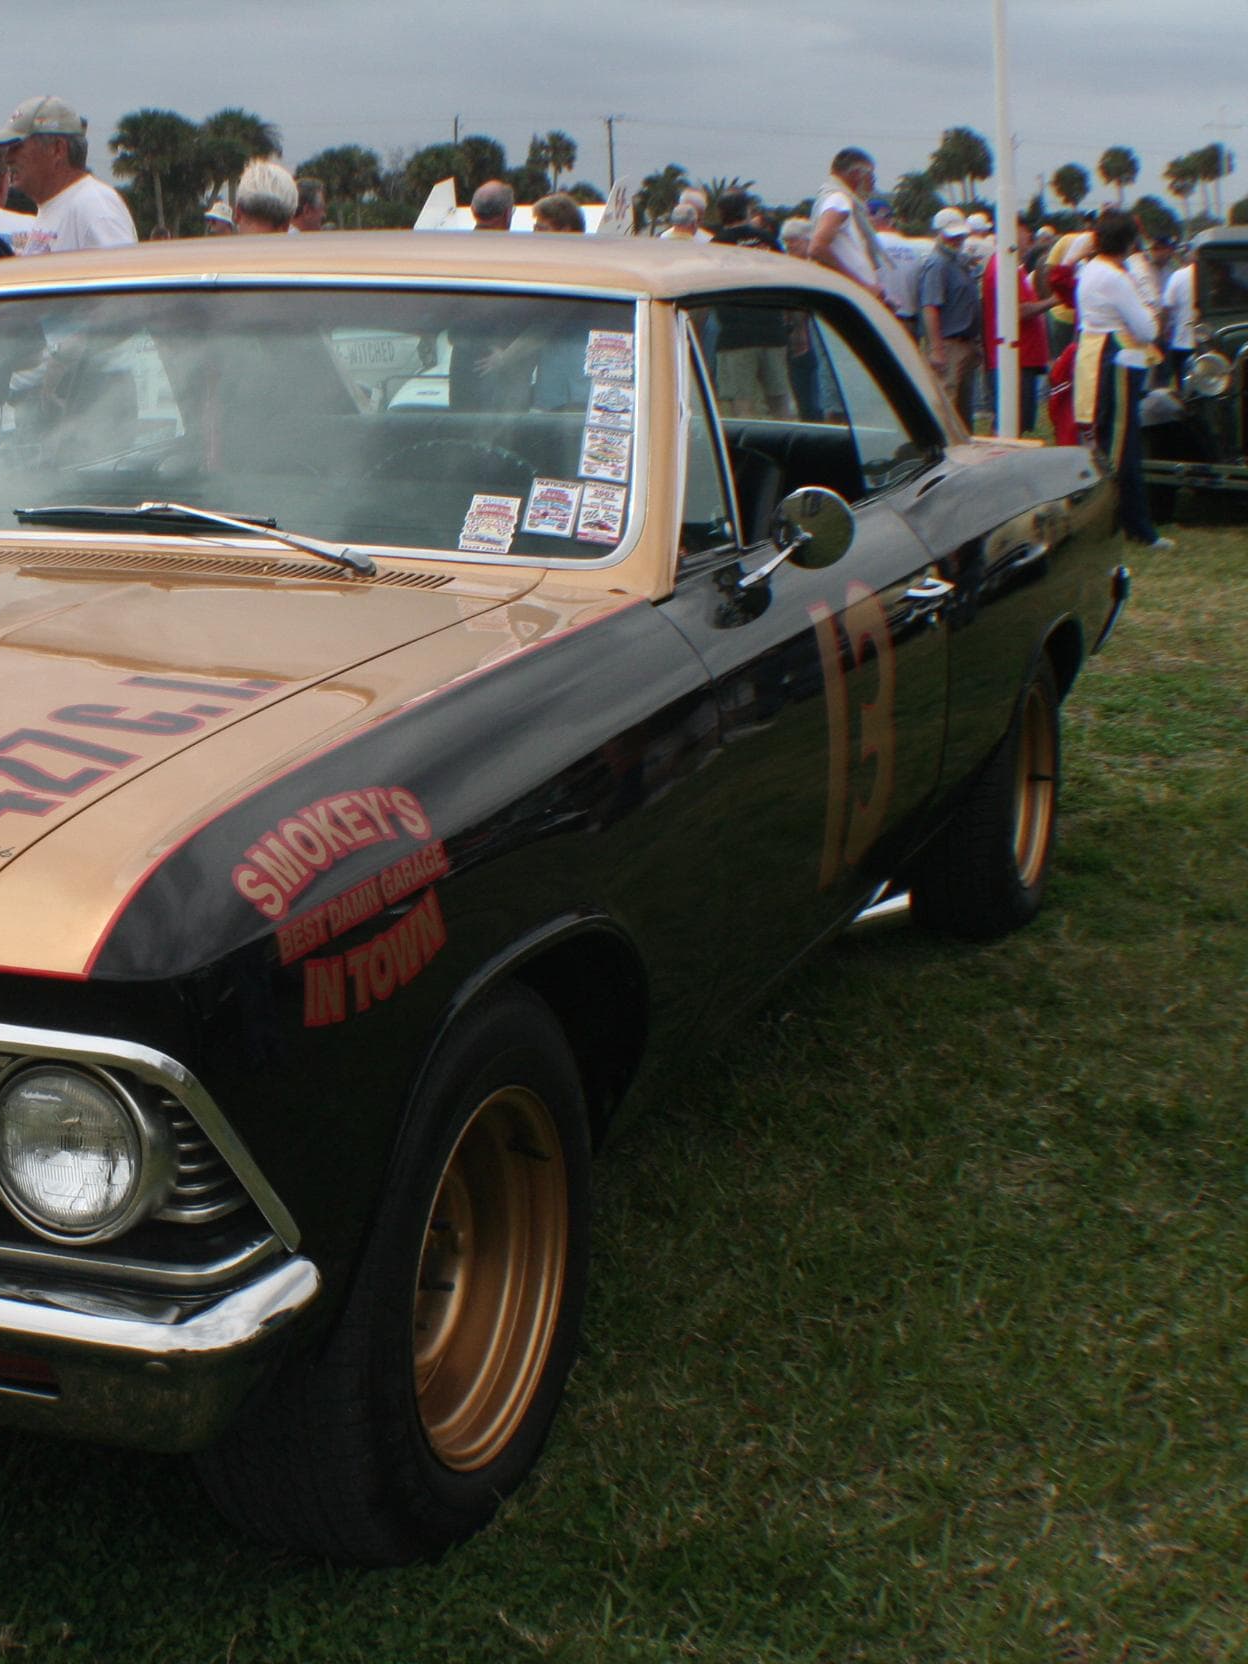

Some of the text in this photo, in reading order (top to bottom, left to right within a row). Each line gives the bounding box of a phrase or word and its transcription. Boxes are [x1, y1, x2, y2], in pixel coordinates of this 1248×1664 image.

[807, 578, 894, 892] 13
[232, 785, 432, 921] SMOKEY'S
[276, 838, 449, 967] BEST DAMN GARAGE
[304, 885, 447, 1028] IN TOWN
